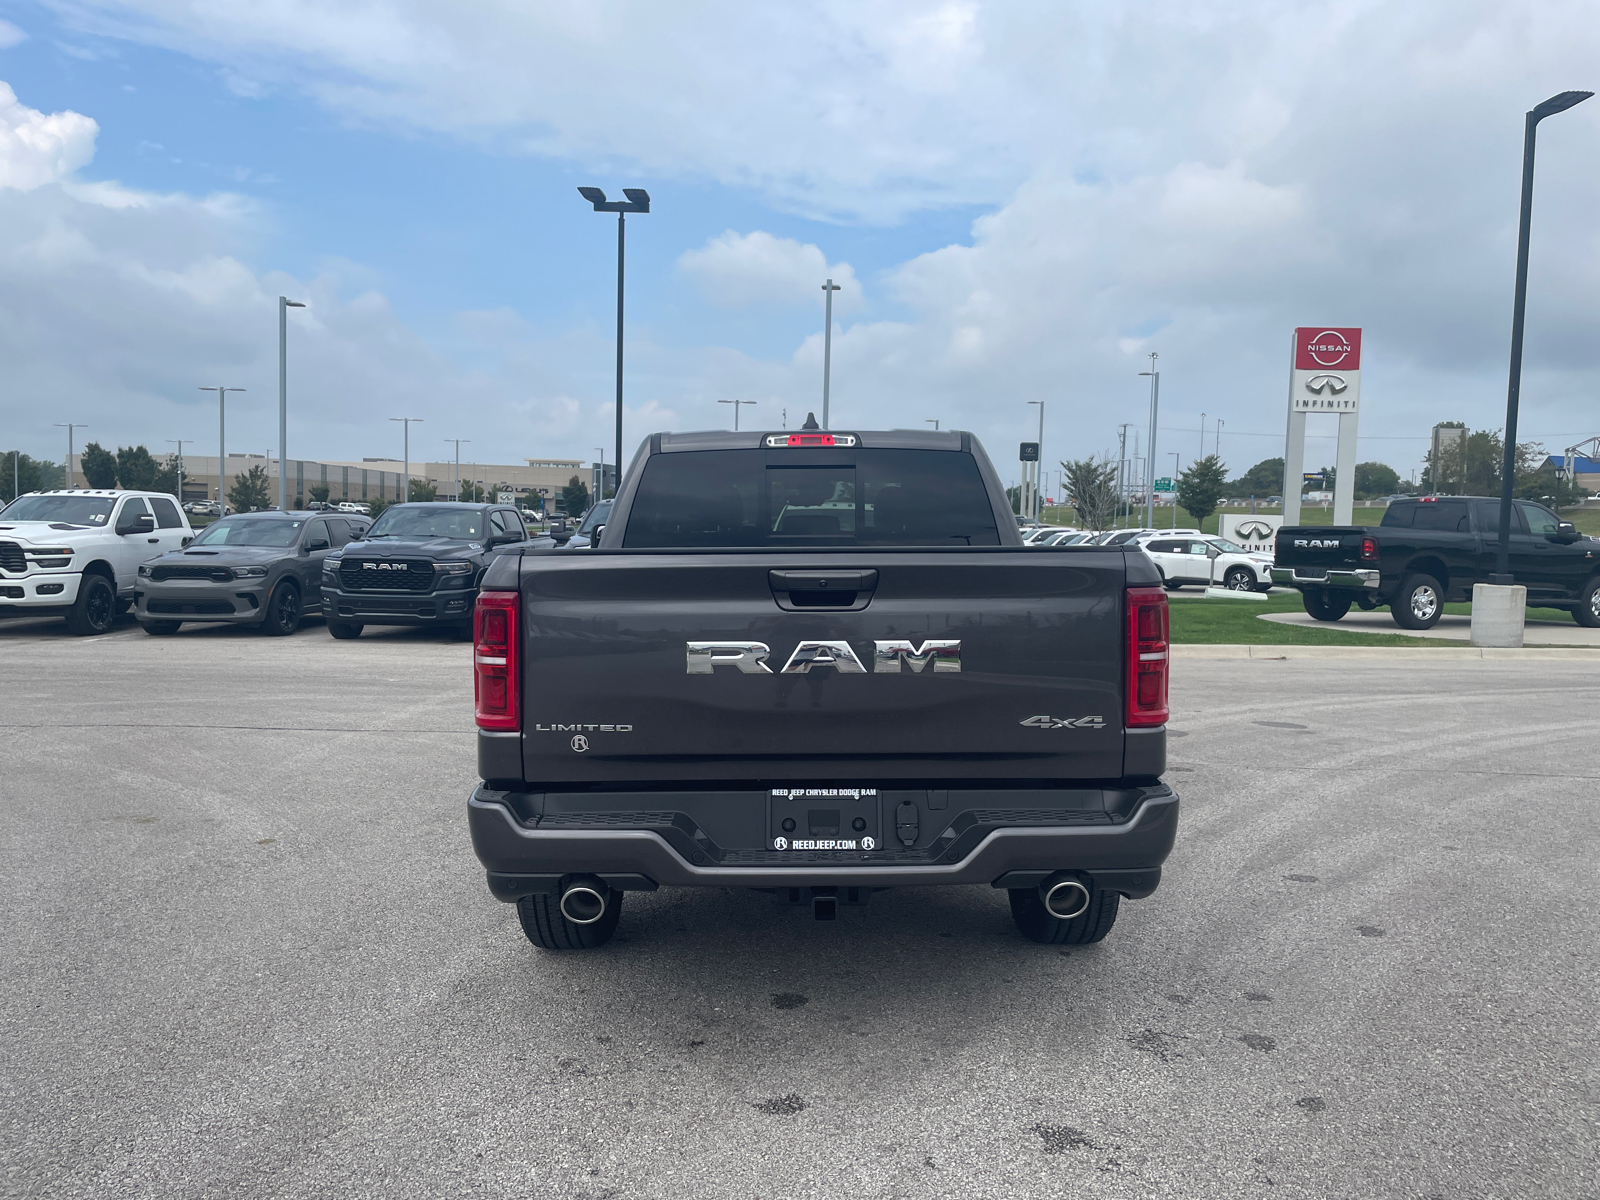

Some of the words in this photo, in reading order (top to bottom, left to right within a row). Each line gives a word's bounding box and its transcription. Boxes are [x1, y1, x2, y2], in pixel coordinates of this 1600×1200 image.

[1296, 399, 1356, 408] INFINITI
[1294, 539, 1340, 548] RAM
[362, 562, 408, 571] RAM
[686, 640, 961, 674] RAM
[1020, 715, 1106, 729] 4x4
[535, 723, 633, 732] LIMITED
[772, 788, 788, 796] REED
[790, 788, 805, 796] JEEP
[806, 788, 838, 796] CHRYSLER
[839, 788, 860, 796] DODGE
[861, 788, 877, 796] RAM
[792, 840, 856, 850] REEDJEEP.COM
